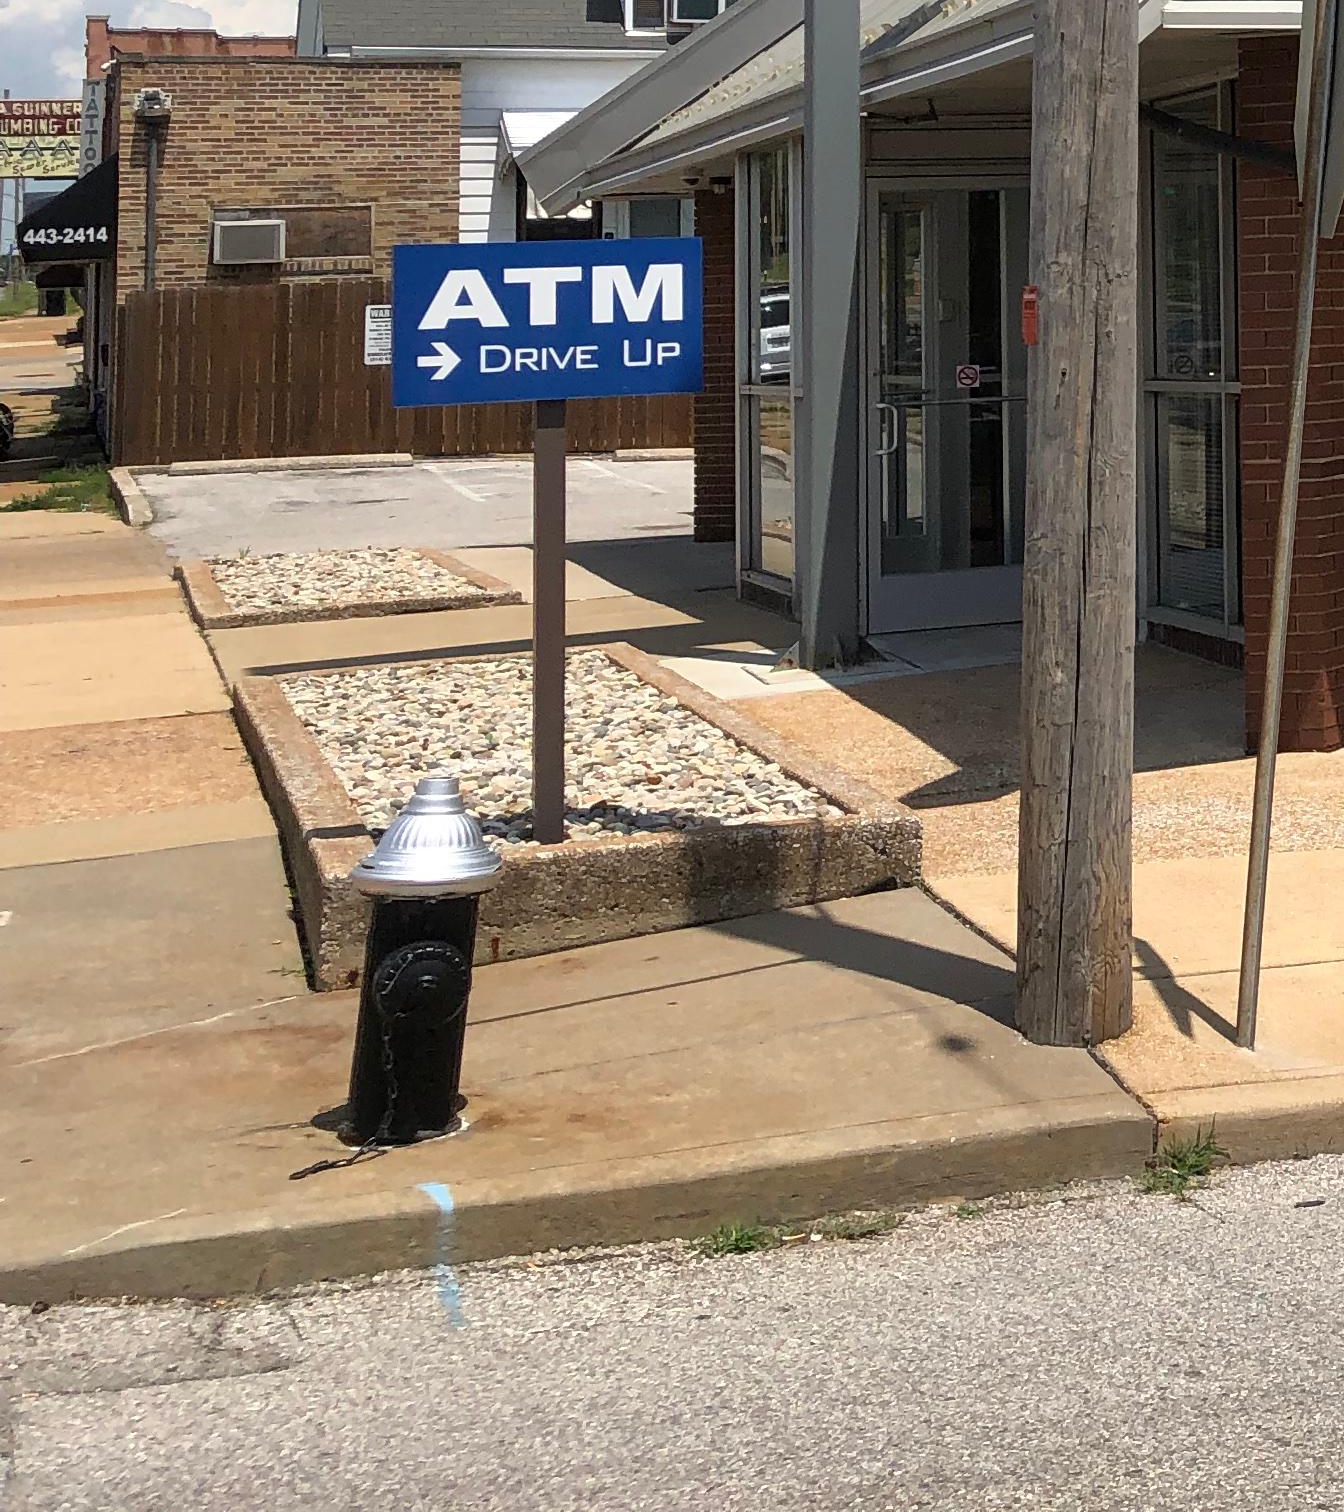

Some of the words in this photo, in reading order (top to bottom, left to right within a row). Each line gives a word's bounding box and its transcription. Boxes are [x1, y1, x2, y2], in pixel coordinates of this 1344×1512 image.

[23, 226, 108, 245] 443-2414
[417, 263, 684, 330] ATM
[479, 344, 599, 373] DRIVE
[623, 338, 681, 366] UP
